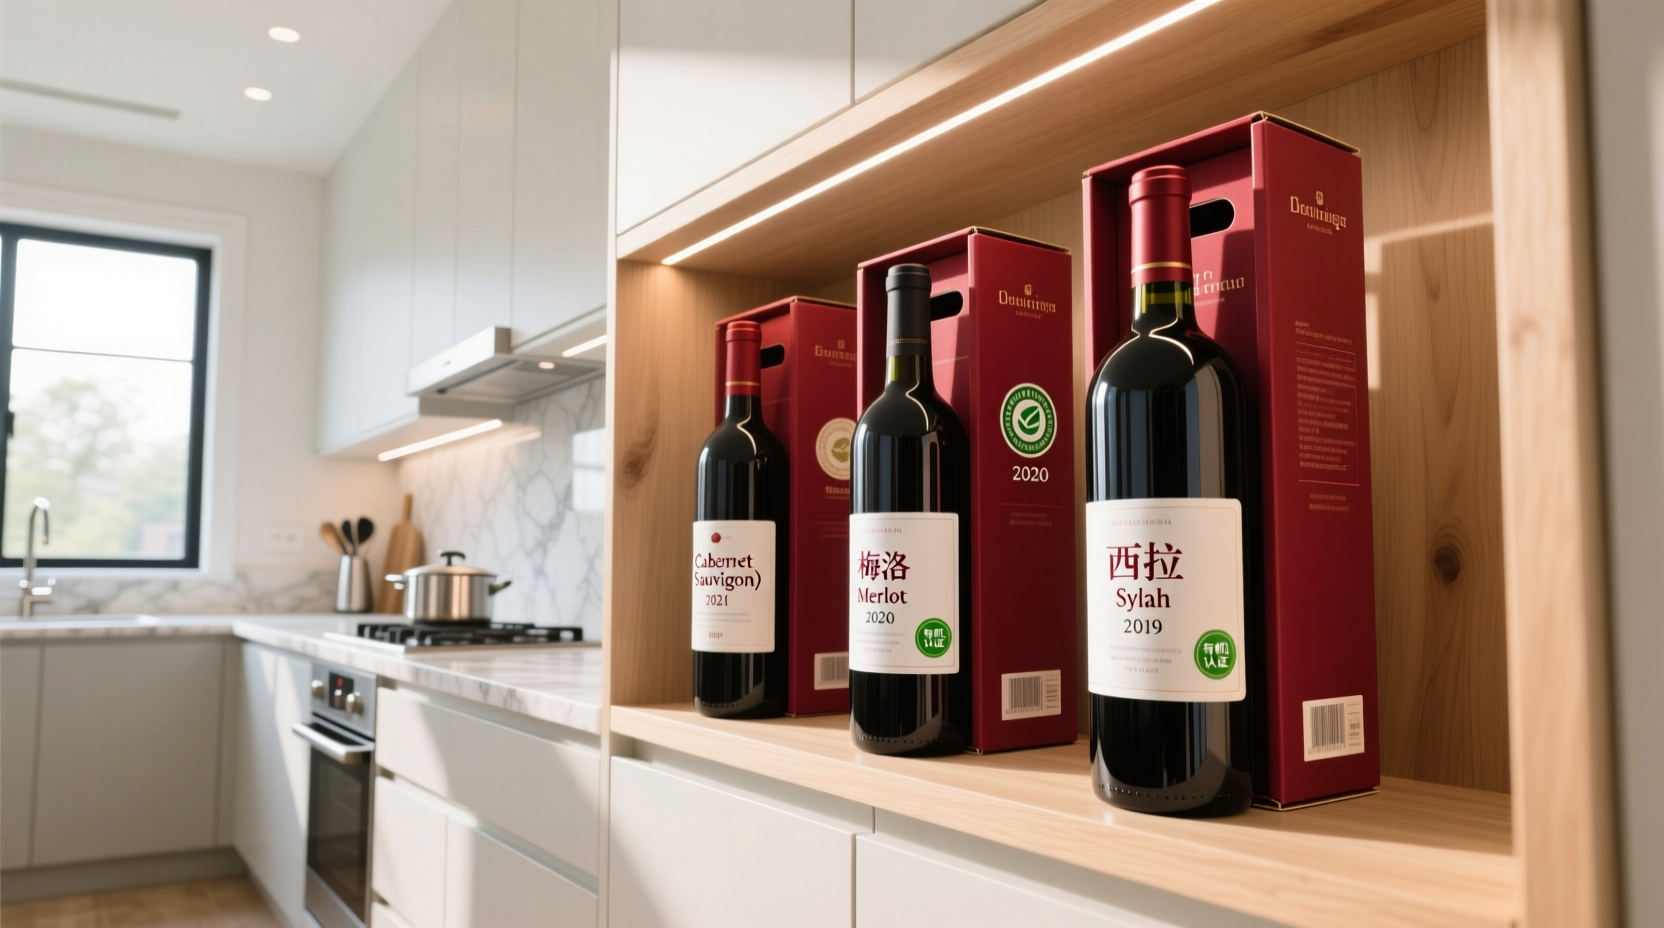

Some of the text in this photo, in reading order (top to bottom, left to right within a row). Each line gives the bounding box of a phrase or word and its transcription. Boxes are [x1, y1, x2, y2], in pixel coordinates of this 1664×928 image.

[1012, 465, 1049, 483] 2020
[857, 550, 911, 581] 梅洛
[1106, 541, 1184, 581] 西拉
[857, 586, 908, 604] Merlot
[1116, 587, 1171, 612] Sylah
[865, 611, 895, 625] 2020
[1123, 618, 1163, 635] 2019
